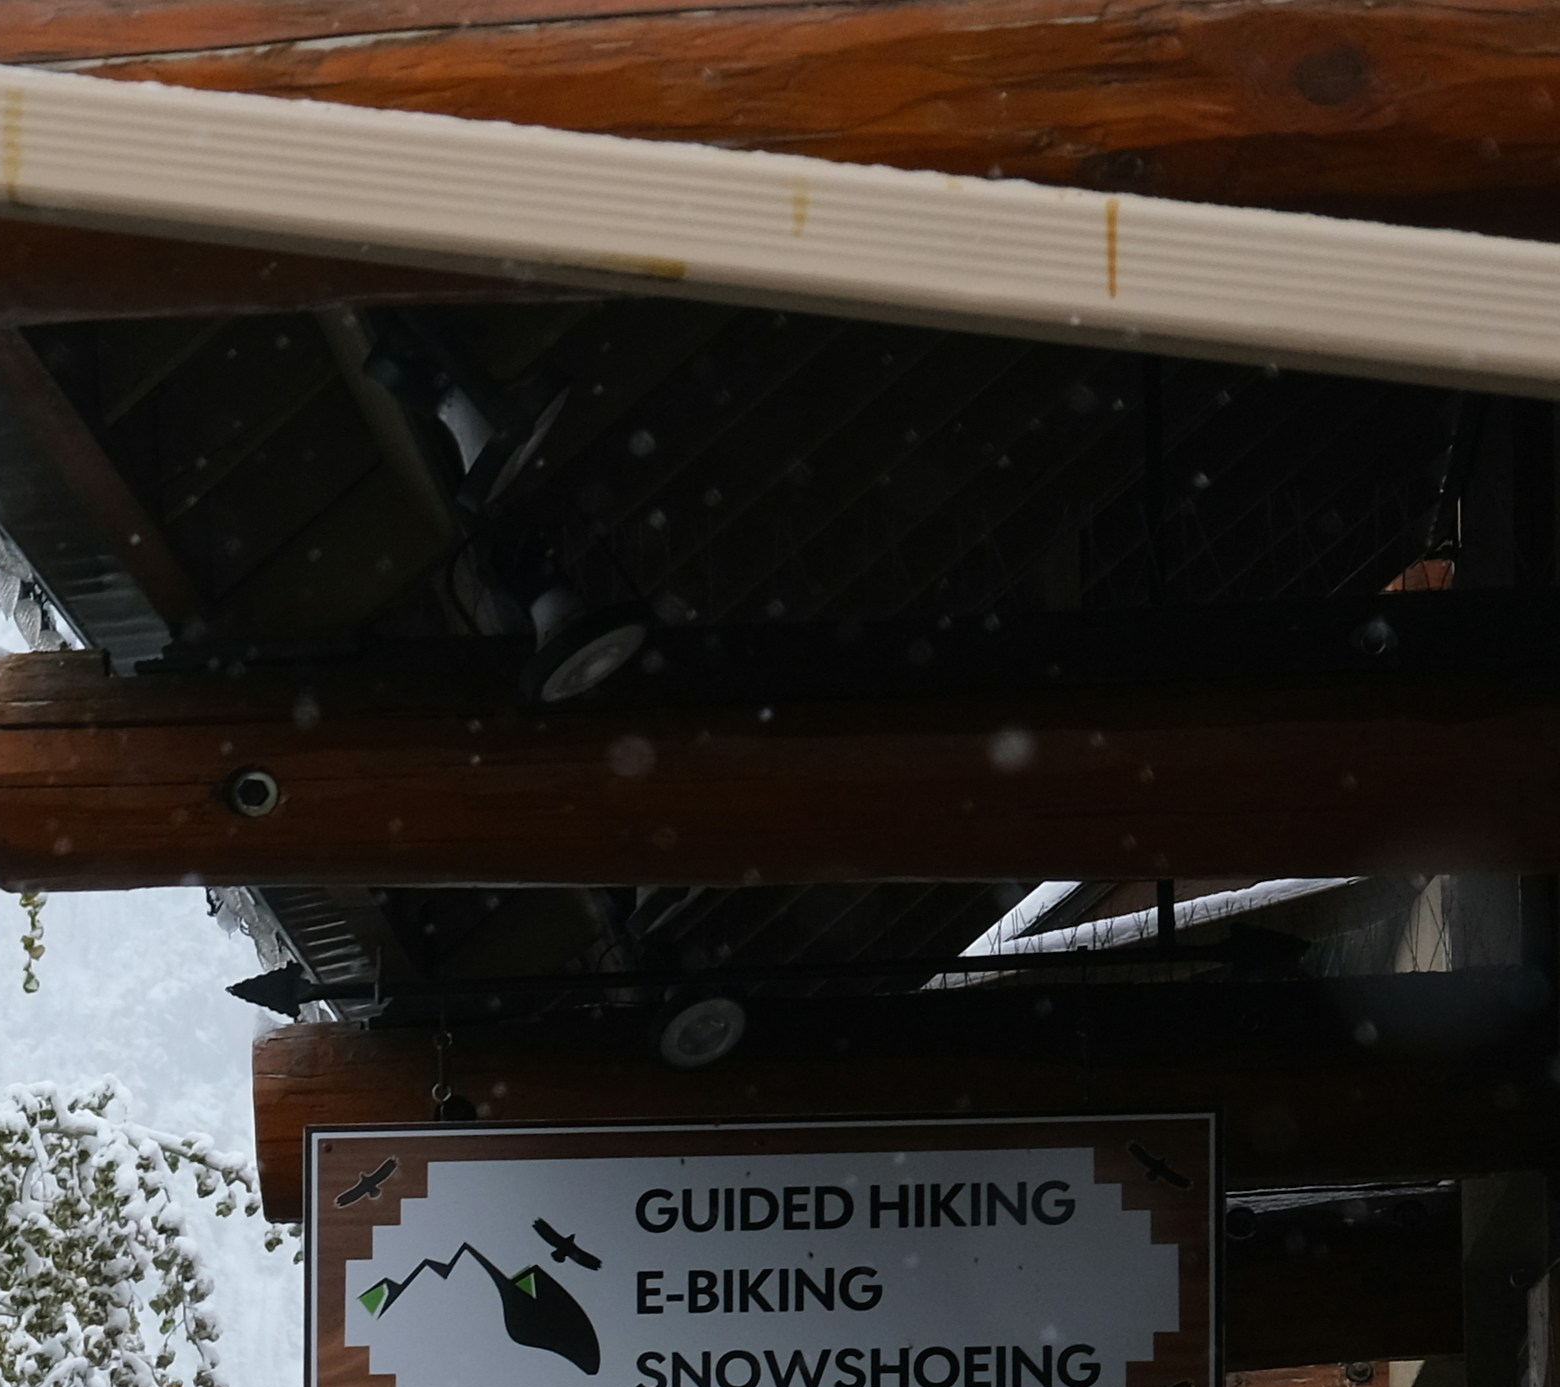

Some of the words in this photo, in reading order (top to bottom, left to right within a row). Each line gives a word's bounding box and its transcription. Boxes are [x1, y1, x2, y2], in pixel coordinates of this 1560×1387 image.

[635, 1186, 855, 1234] GUIDED
[868, 1180, 1076, 1229] HIKING
[636, 1266, 884, 1315] E-BIKING
